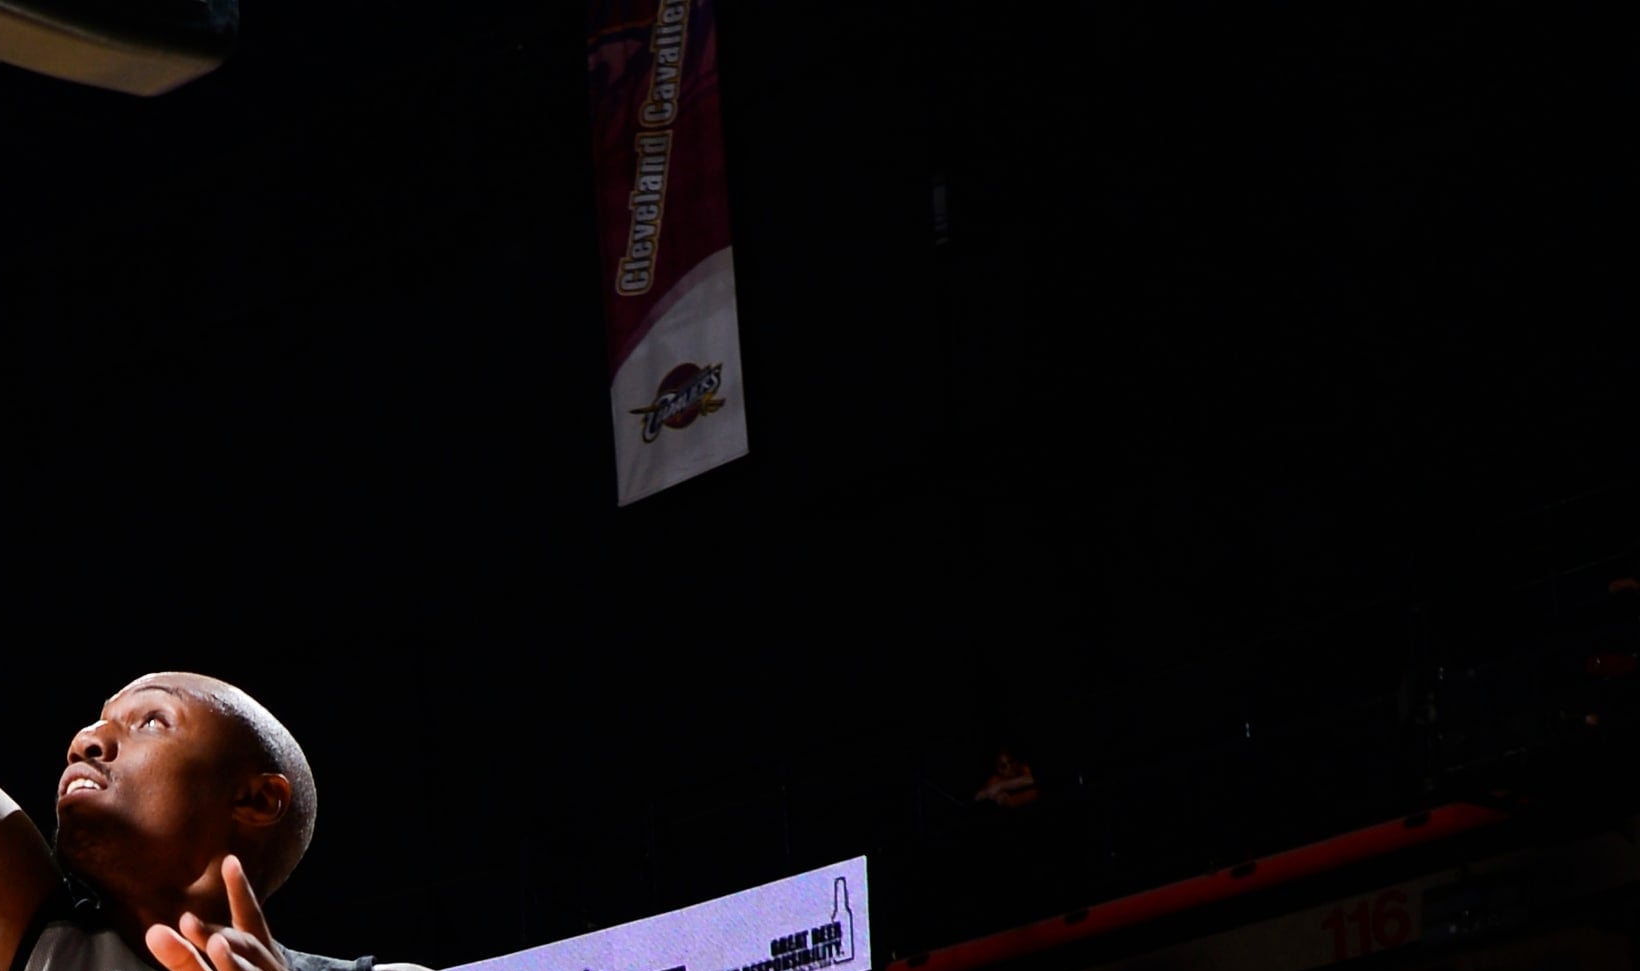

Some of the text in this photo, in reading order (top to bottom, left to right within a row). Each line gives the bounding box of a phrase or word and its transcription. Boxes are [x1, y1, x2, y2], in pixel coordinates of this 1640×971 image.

[615, 0, 691, 296] Cleveland Cavalie
[1322, 890, 1410, 961] 116
